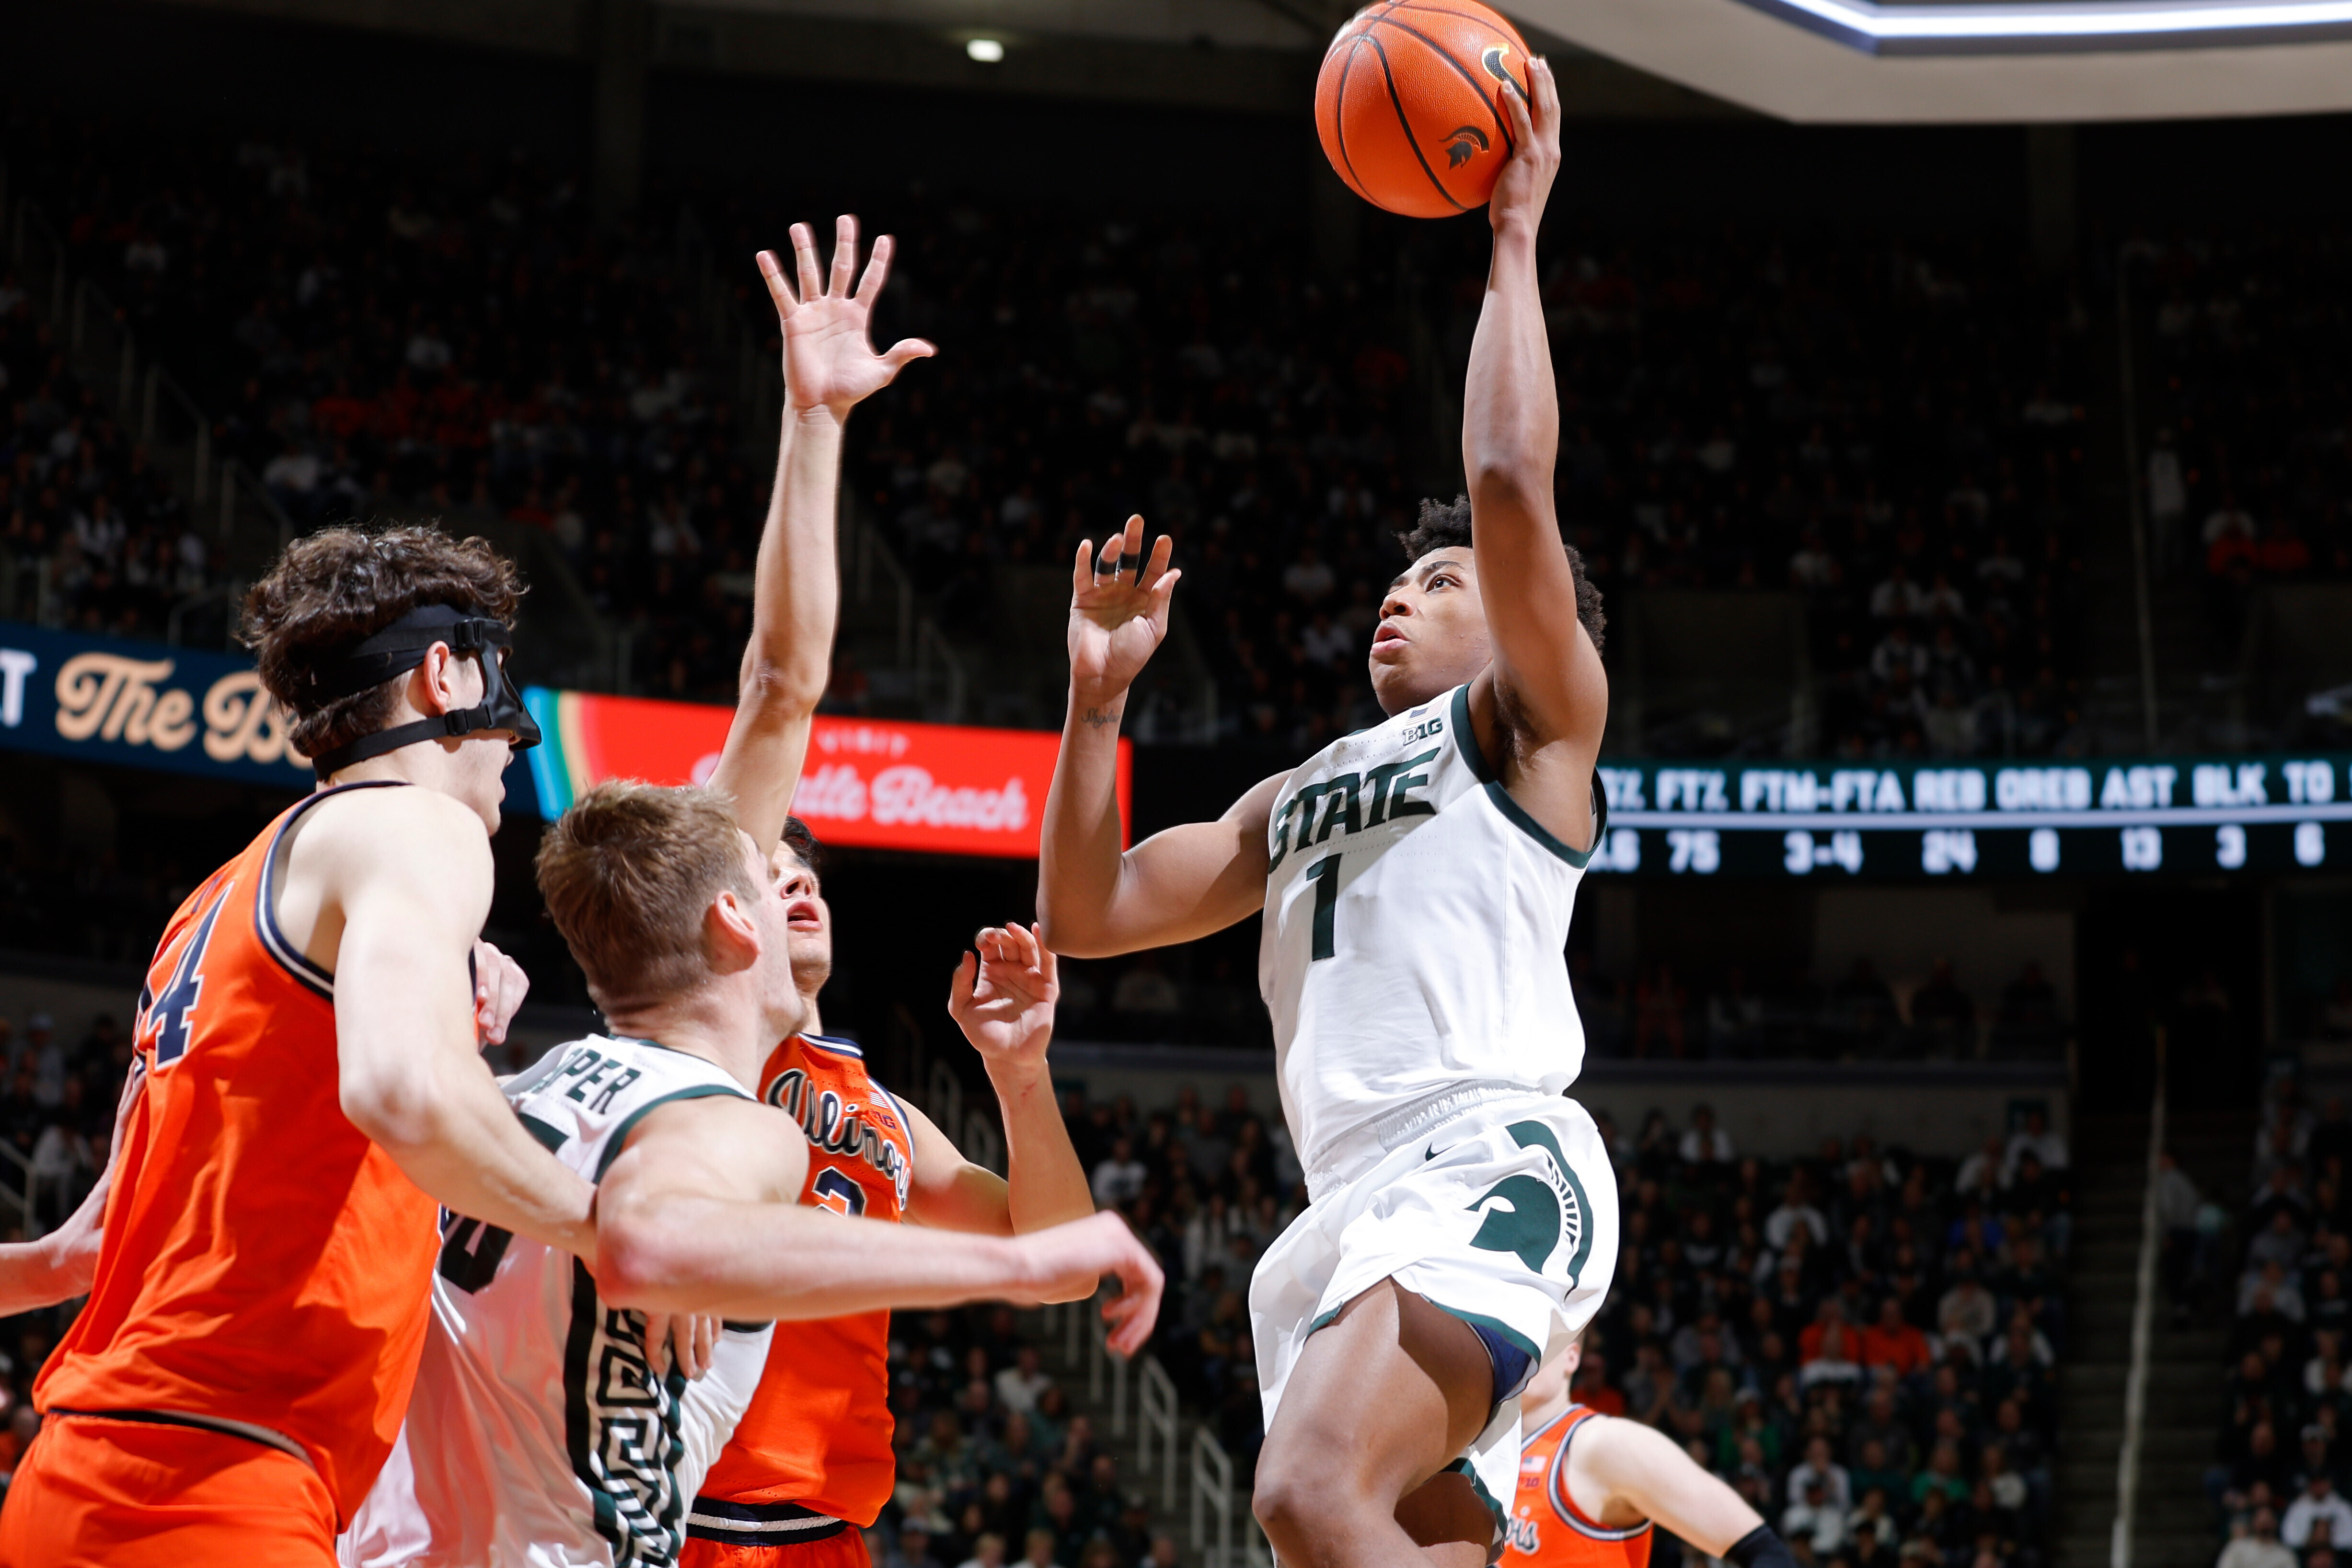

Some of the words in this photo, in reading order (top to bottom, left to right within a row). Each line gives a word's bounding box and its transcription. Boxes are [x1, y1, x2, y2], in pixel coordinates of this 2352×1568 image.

[55, 652, 195, 750] The
[869, 765, 1028, 831] Beach
[1268, 747, 1441, 874] STATE
[1740, 769, 1906, 811] FTM-FTA
[2100, 765, 2178, 808] AST
[2192, 763, 2268, 807] BLK
[2283, 760, 2335, 804] TO
[1667, 829, 1720, 873] 75
[1784, 830, 1863, 874] 3-4
[1922, 830, 1977, 874] 24
[2121, 827, 2162, 870] 13
[2216, 825, 2246, 868] 3
[1306, 853, 1342, 962] 1
